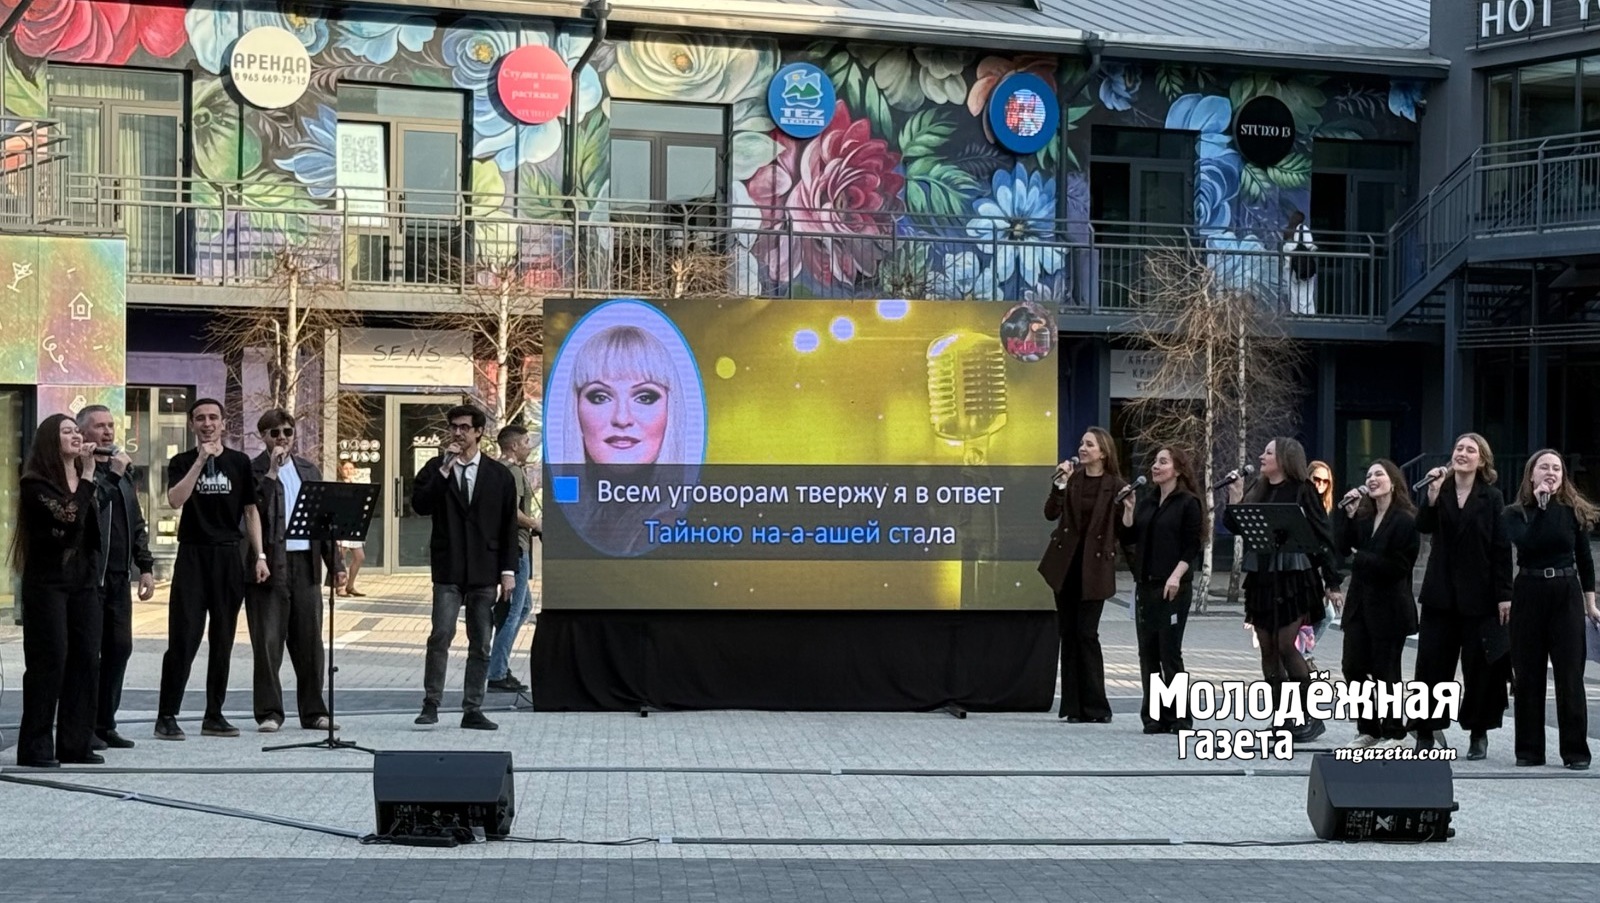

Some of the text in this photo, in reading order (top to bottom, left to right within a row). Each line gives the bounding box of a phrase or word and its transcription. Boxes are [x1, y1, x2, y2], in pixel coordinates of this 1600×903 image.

[233, 52, 307, 75] АРЕНДА
[242, 73, 259, 82] 965
[262, 74, 306, 86] 669-75-15
[780, 107, 825, 119] TEZ
[371, 339, 441, 362] SENS
[597, 479, 1004, 509] Всем уговорам твержу я в ответ
[644, 519, 956, 544] Тайною на-а-ашей стала
